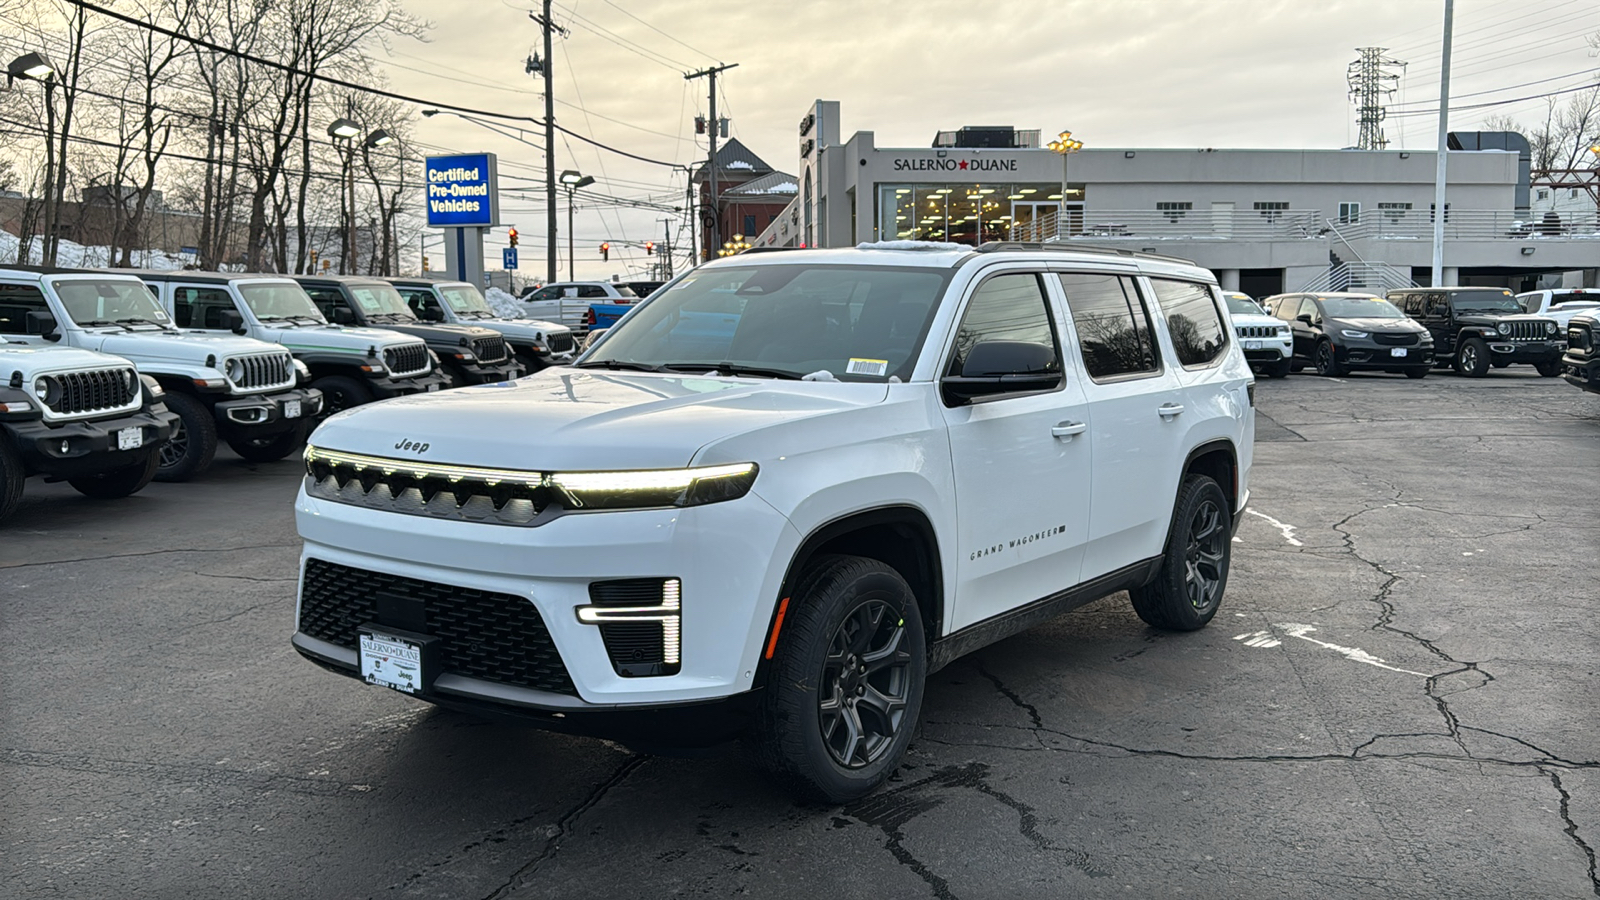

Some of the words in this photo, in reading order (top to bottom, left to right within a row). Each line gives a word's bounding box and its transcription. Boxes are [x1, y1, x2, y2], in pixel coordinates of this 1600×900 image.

[894, 158, 957, 171] SALERNO
[970, 159, 1018, 171] DUANE
[428, 167, 479, 182] Certified
[429, 183, 487, 197] Pre-Owned
[430, 199, 480, 213] Vehicles
[506, 252, 515, 264] H
[394, 438, 430, 454] Jeep
[970, 543, 1004, 561] GRAND
[1009, 527, 1058, 548] WAGONEER
[362, 640, 393, 655] SALERNO
[395, 647, 419, 661] DUANE
[398, 670, 413, 681] Jeep
